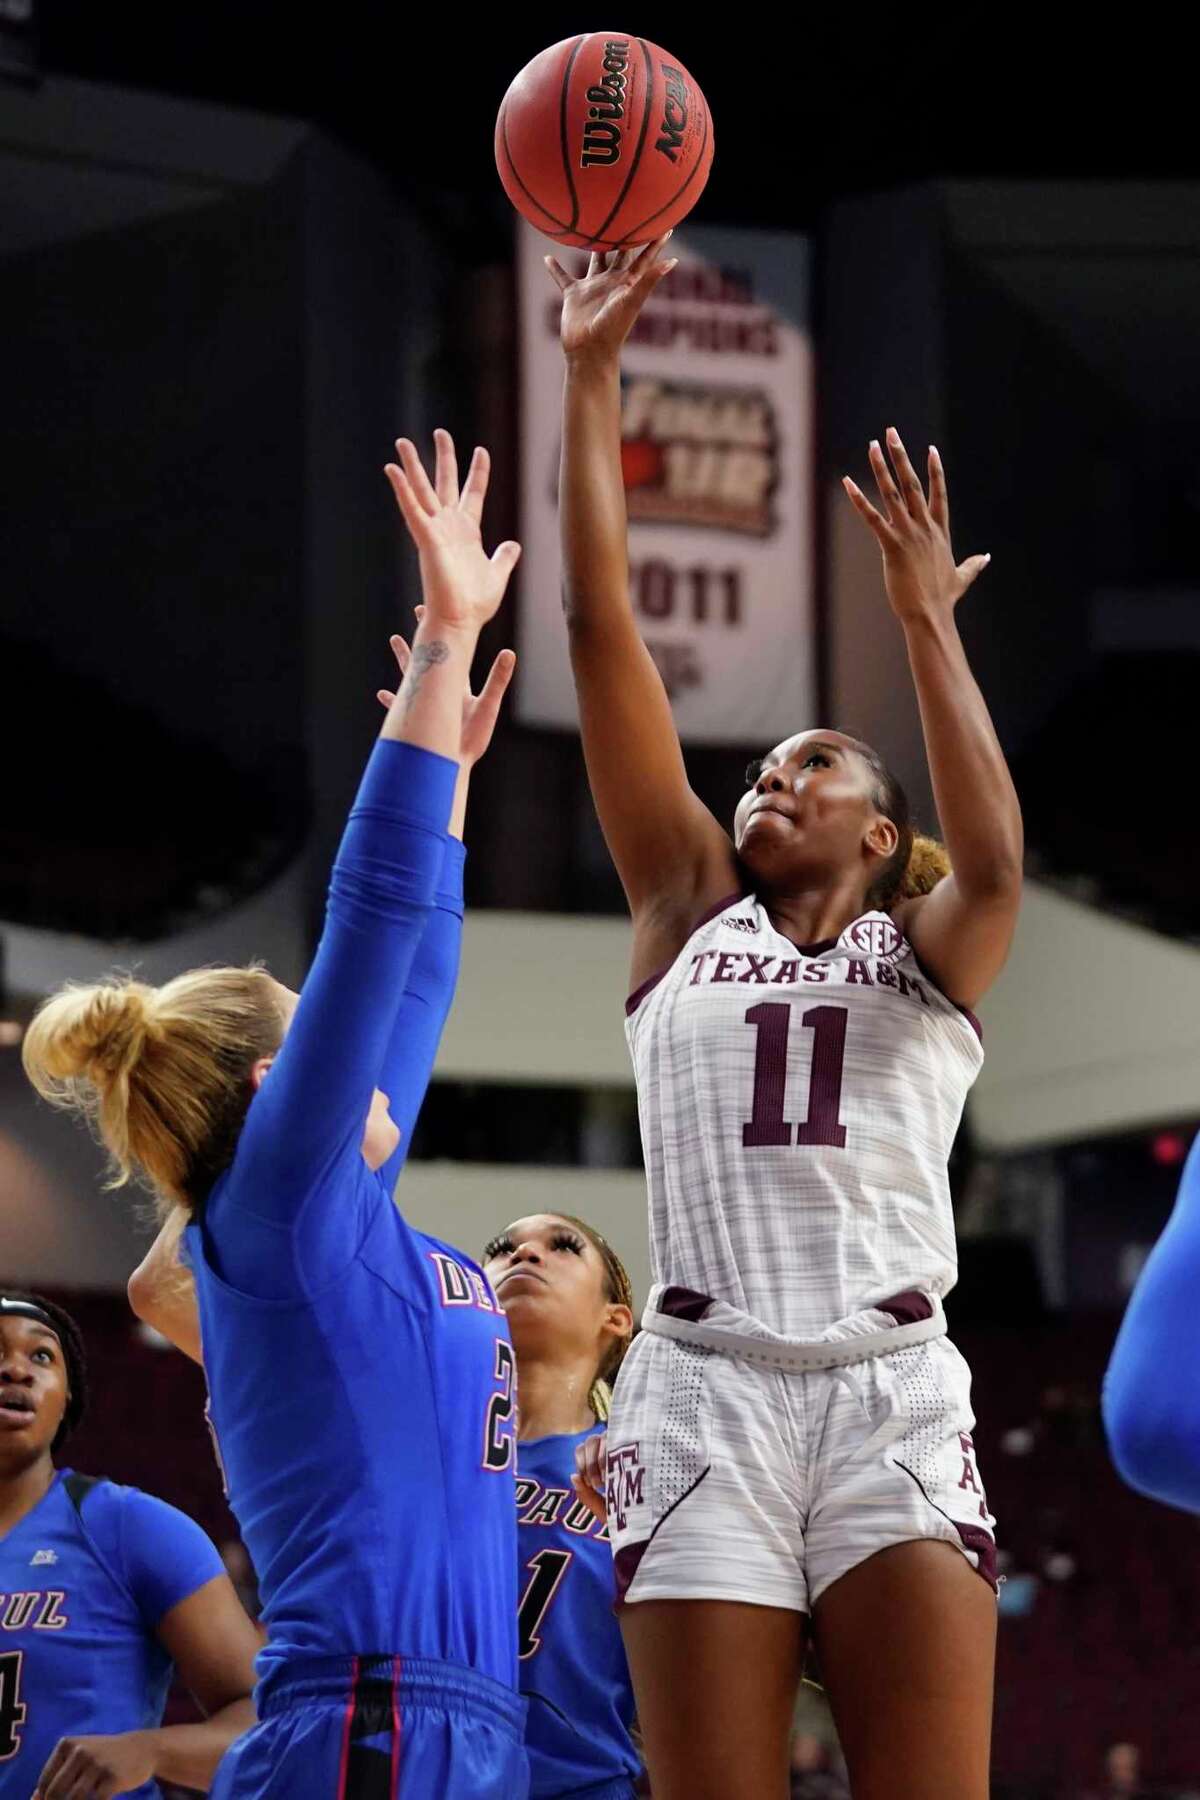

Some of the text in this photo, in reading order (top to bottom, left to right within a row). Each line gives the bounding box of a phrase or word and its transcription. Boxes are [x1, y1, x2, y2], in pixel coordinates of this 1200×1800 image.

[580, 39, 631, 168] Wilson
[655, 63, 688, 163] NCAA
[628, 556, 744, 628] 011
[855, 922, 899, 955] SEC
[689, 950, 930, 1007] TEXAS A&M
[742, 1001, 849, 1149] 11
[0, 1590, 69, 1631] UL
